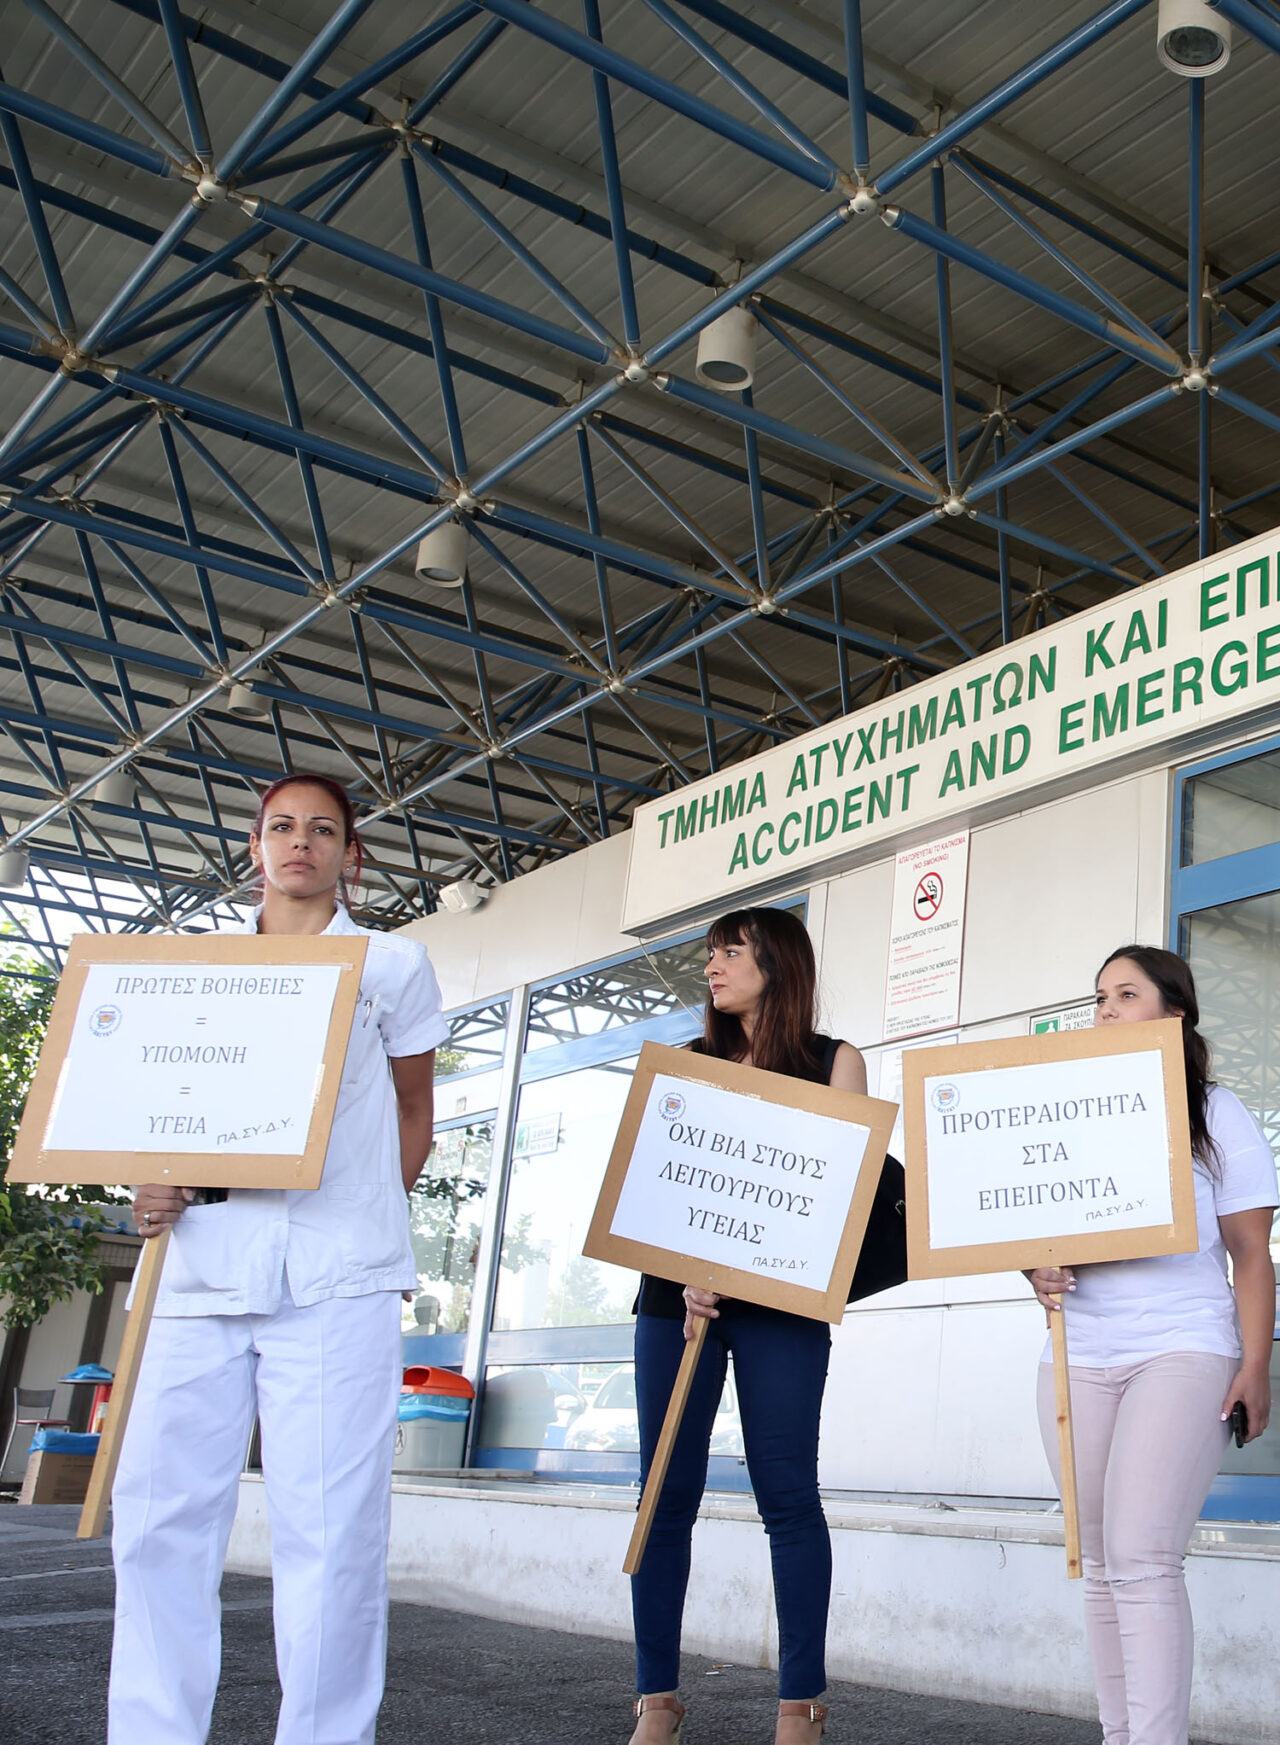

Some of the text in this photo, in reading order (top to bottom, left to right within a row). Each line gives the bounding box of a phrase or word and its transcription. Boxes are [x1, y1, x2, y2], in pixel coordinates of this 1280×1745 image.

[657, 771, 766, 849] ΤΜΗΜΑ
[786, 645, 1057, 798] ΑΤΥΧΗΜΑΤΩΝ
[1085, 598, 1168, 677] ΚΑΙ
[728, 763, 920, 876] ACCIDENT
[938, 723, 1031, 798] AND
[115, 977, 304, 996] ΠΡΩΤΕΣ ΒΟΗΘΕΙΕΣ
[141, 1046, 247, 1064] ΥΠΟΜΟΝΗ
[147, 1116, 206, 1135] ΥΓΕΙΑ
[942, 1092, 1147, 1135] ΠΡΟΤΕΡΑΙΟΤΗΤΑ
[669, 1122, 827, 1180] ΟΧΙ ΒΙΑ ΣΤΟΥΣ
[1022, 1141, 1069, 1166] ΣΤΑ
[658, 1160, 814, 1217] ΛΕΙΤΟΥΡΓΟΥΣ
[978, 1176, 1119, 1212] ΕΠΕΙΓΟΝΤΑ
[687, 1206, 765, 1245] ΥΓΕΙΑΣ
